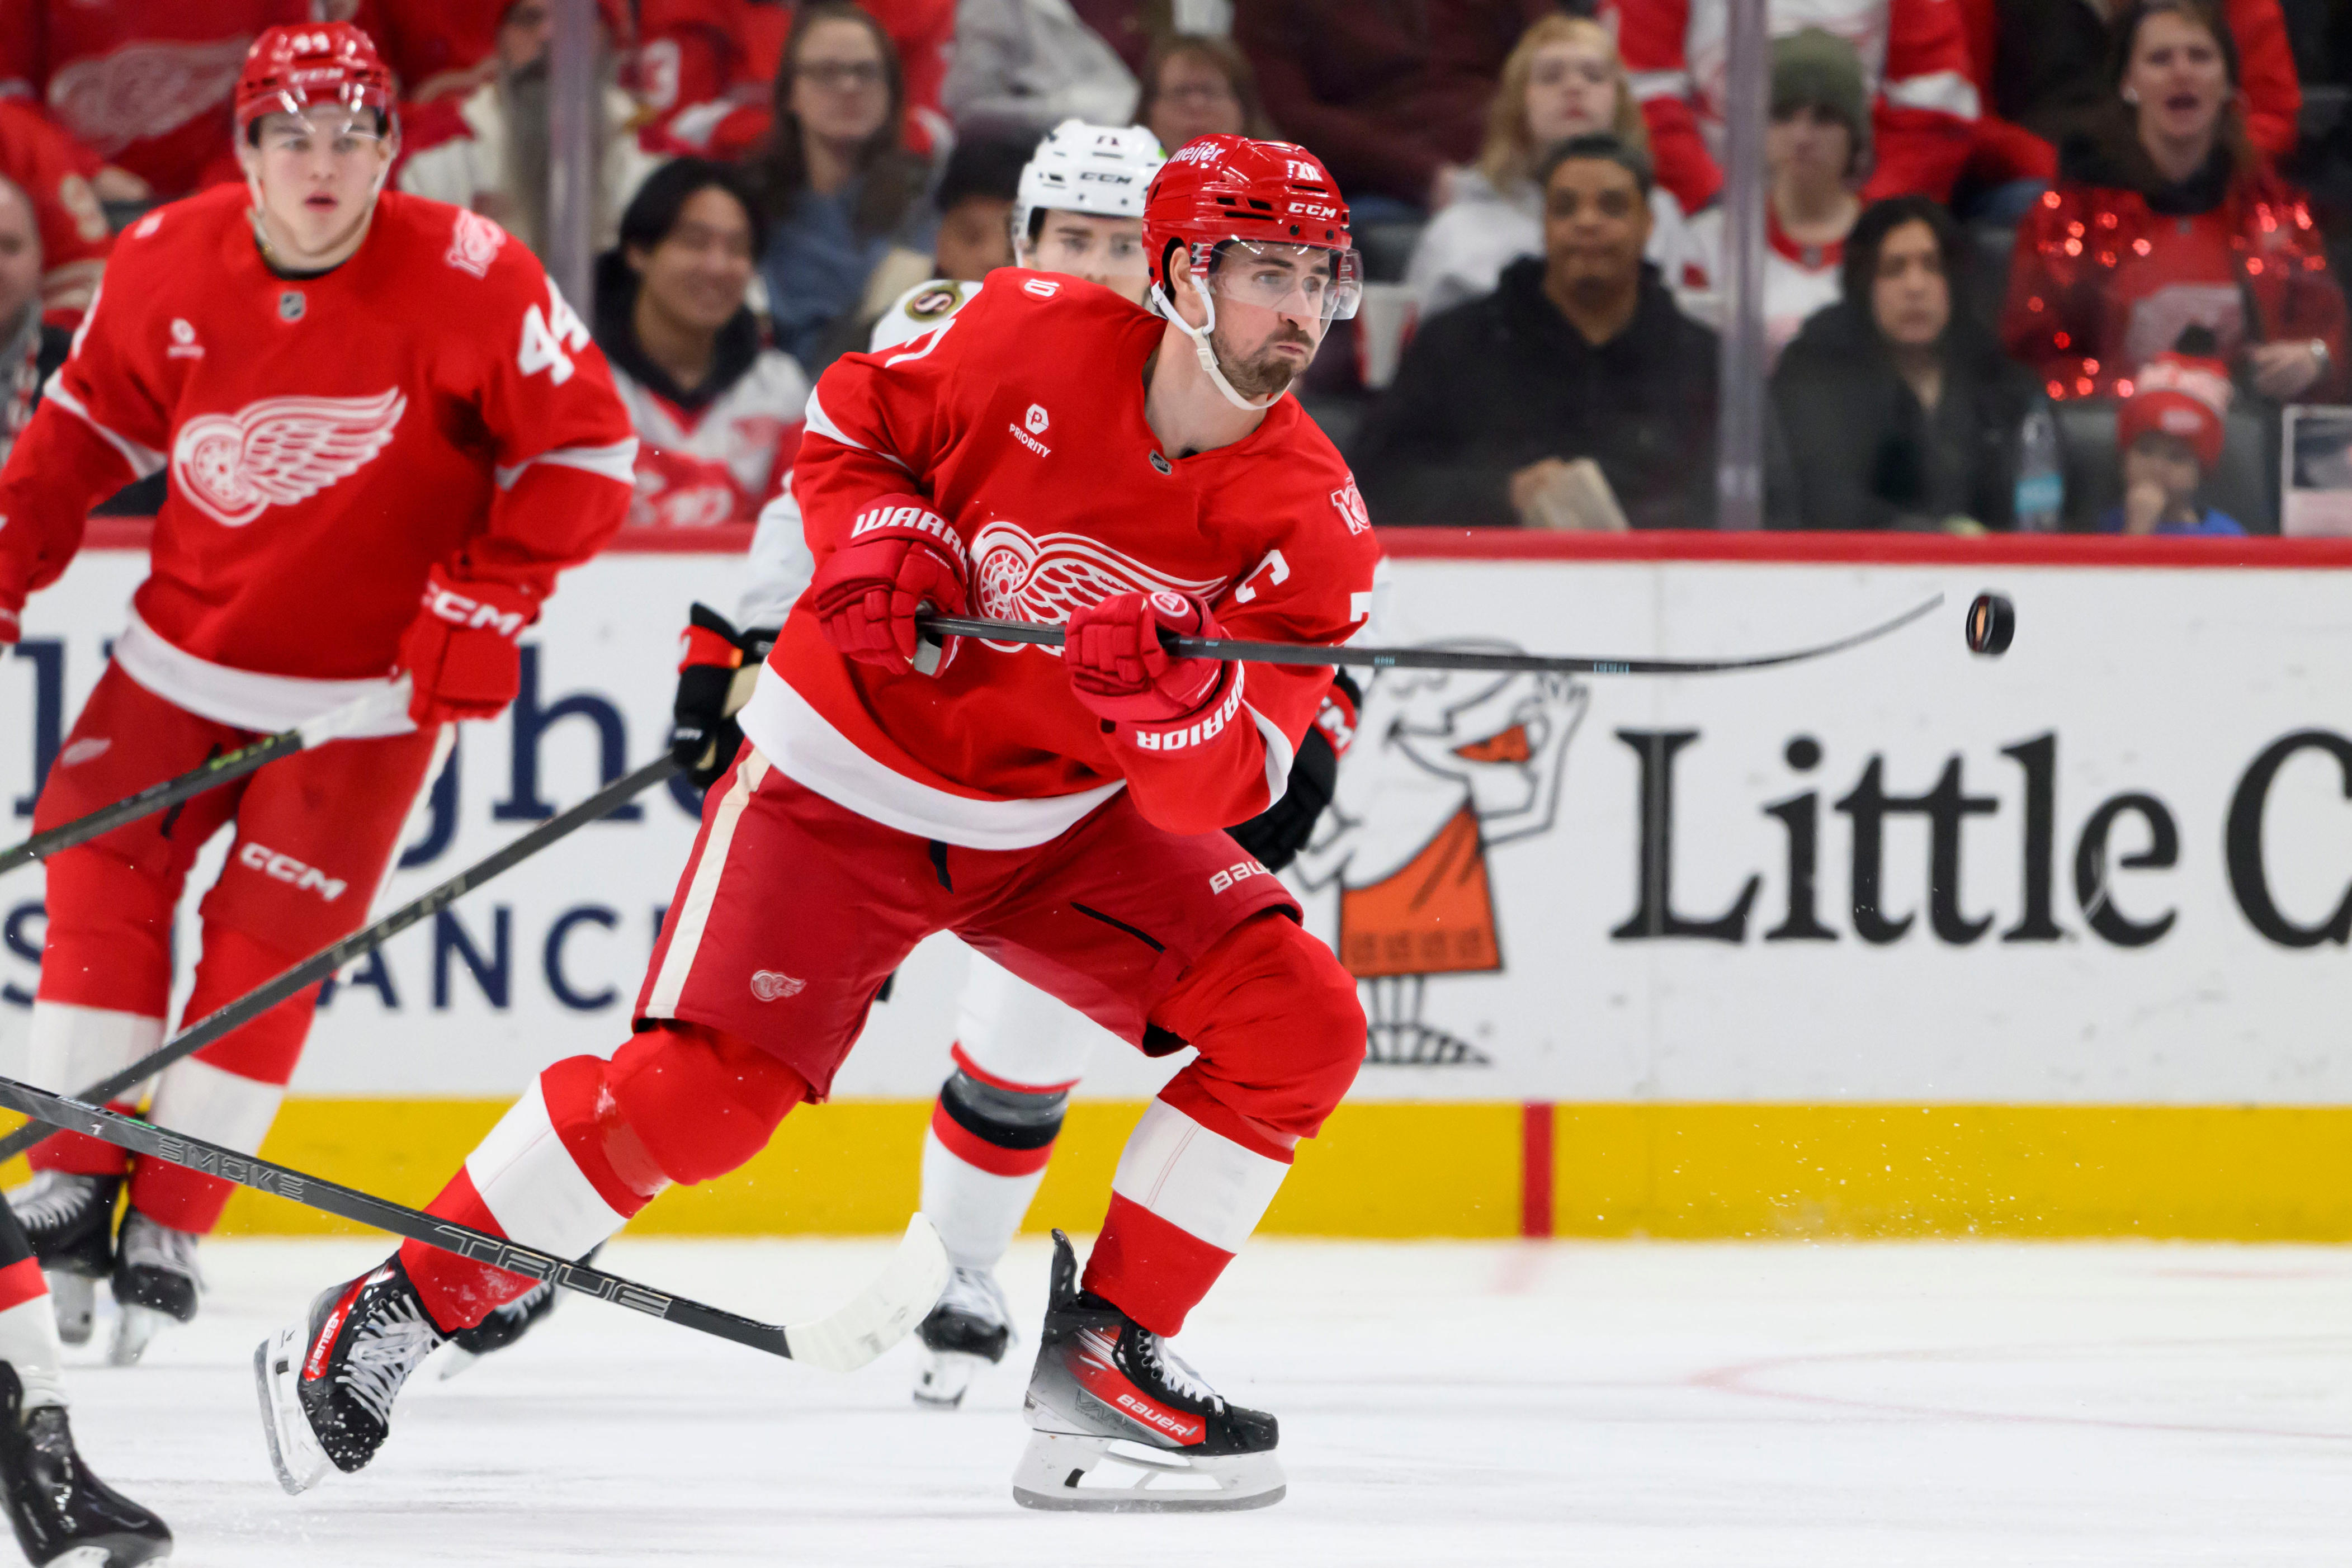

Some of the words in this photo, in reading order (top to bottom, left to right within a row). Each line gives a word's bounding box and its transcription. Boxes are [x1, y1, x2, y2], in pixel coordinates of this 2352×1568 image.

[1167, 141, 1226, 166] meijer
[1079, 171, 1132, 184] CCM
[1288, 202, 1337, 218] CCM
[1009, 423, 1051, 458] PRIORITY
[1609, 728, 2180, 948] Little
[240, 842, 348, 902] CCM
[434, 1225, 673, 1320] TRUE
